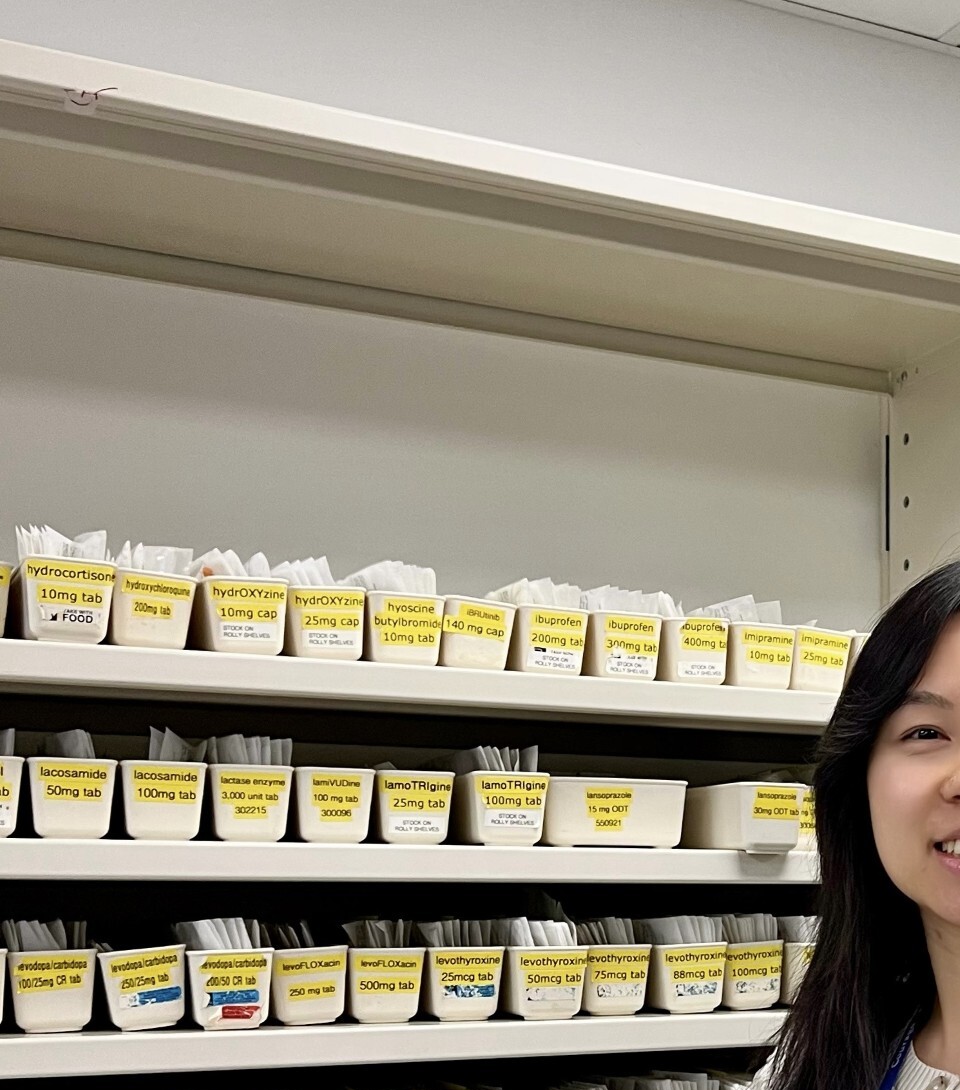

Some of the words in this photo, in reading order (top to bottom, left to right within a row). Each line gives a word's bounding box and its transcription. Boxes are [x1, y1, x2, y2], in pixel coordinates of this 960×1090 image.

[40, 588, 77, 603] 10mg
[82, 592, 103, 603] tab
[213, 586, 285, 602] hydrOXYzine
[220, 607, 253, 620] 10mg
[257, 608, 278, 620] cap
[387, 603, 435, 614] hyoscine
[62, 612, 93, 624] FOOD
[305, 615, 338, 628] 25mg
[341, 617, 360, 628] cap
[535, 614, 582, 627] ibuprofen
[445, 619, 465, 631] 140
[467, 625, 484, 635] mg
[486, 627, 505, 638] cap
[608, 620, 654, 633] ibuprofen
[383, 632, 414, 644] 10mg
[418, 633, 435, 643] tab
[684, 637, 716, 650] 400mg
[744, 632, 793, 646] imipramine
[750, 650, 774, 663] 10mg
[777, 653, 790, 663] tab
[40, 766, 107, 780] lacosamide
[134, 770, 198, 782] lacosamide
[313, 778, 360, 788] lamiVUDine
[385, 780, 451, 793] lamoTRIgine
[481, 780, 547, 792] lamoTRIgine
[46, 785, 80, 799] 50mg
[83, 787, 102, 798] tab
[137, 787, 175, 800] 100mg
[178, 789, 196, 800] tab
[393, 798, 424, 810] 25mg
[428, 799, 445, 809] tab
[485, 796, 521, 808] 100mg
[524, 796, 542, 806] tab
[235, 806, 267, 815] 302215
[441, 972, 475, 983] 25mcg
[478, 972, 494, 981] tab
[594, 970, 627, 980] 75mcg
[630, 970, 645, 979] tab
[732, 967, 767, 978] 100mcg
[527, 973, 562, 985] 50mcg
[565, 973, 582, 982] tab
[360, 980, 395, 991] 500mg
[399, 980, 415, 990] tab
